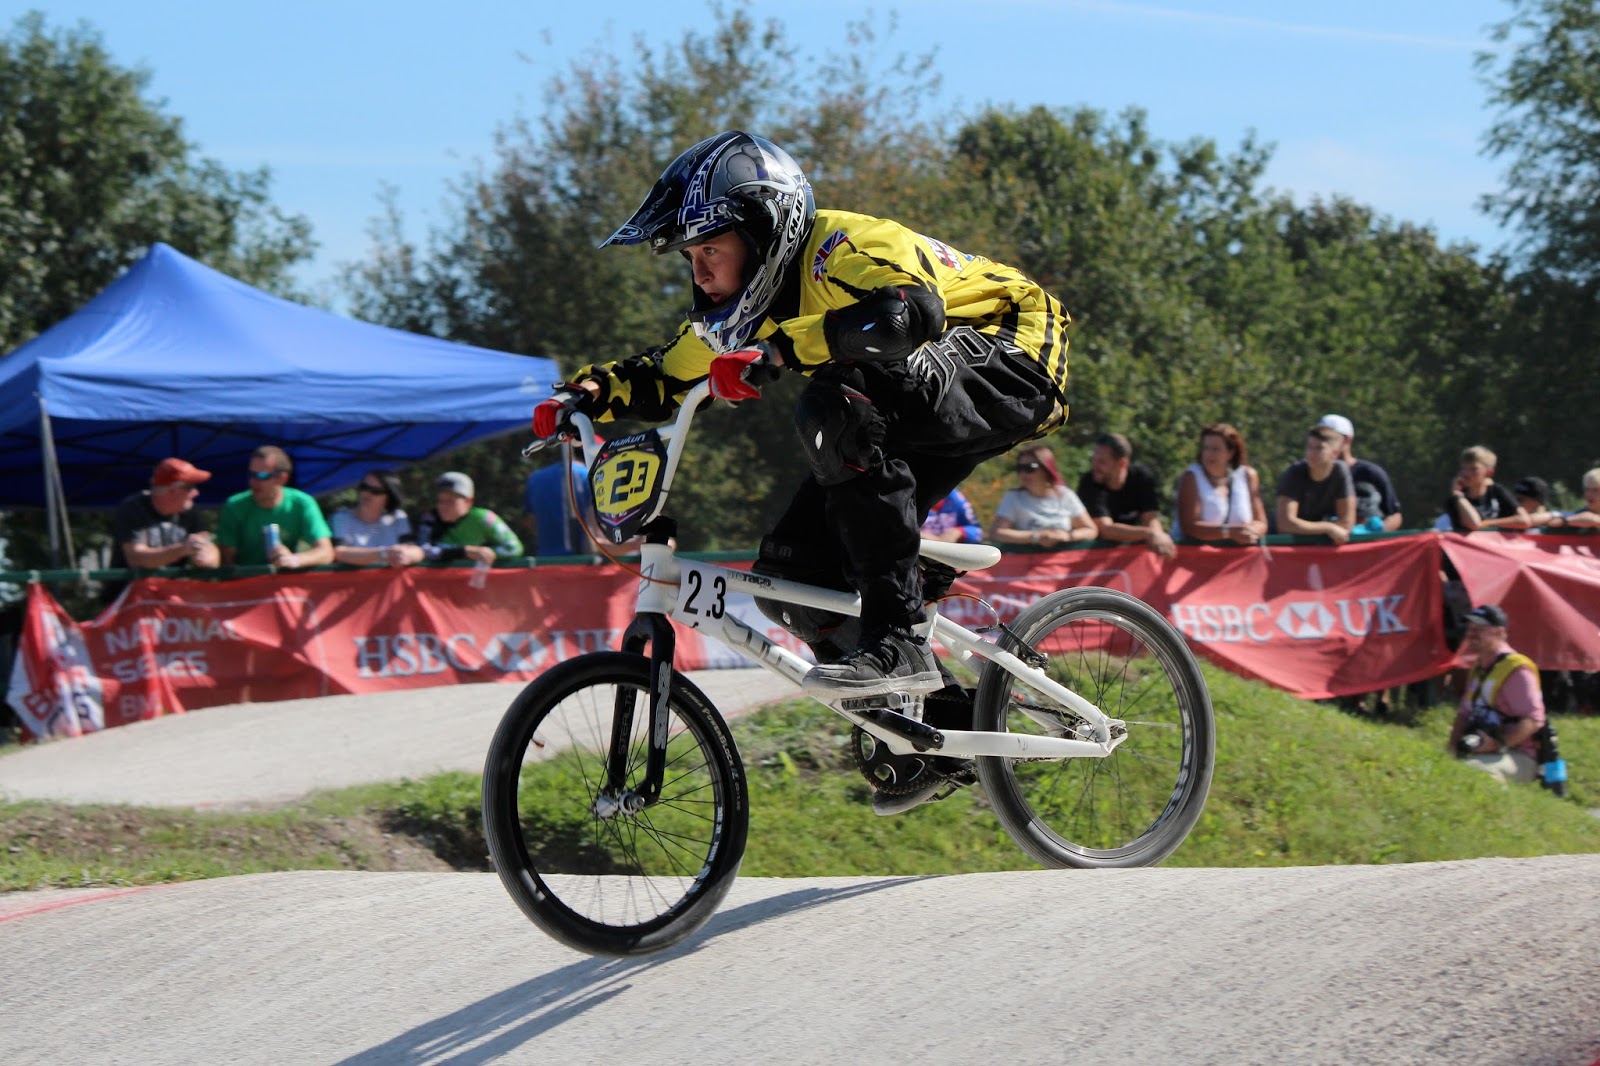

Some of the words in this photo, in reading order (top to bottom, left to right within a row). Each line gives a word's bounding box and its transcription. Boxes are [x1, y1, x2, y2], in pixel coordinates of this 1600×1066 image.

[1168, 602, 1275, 643] HSBC
[1334, 594, 1410, 637] UK
[352, 632, 481, 679] HSBC
[549, 628, 623, 662] UK
